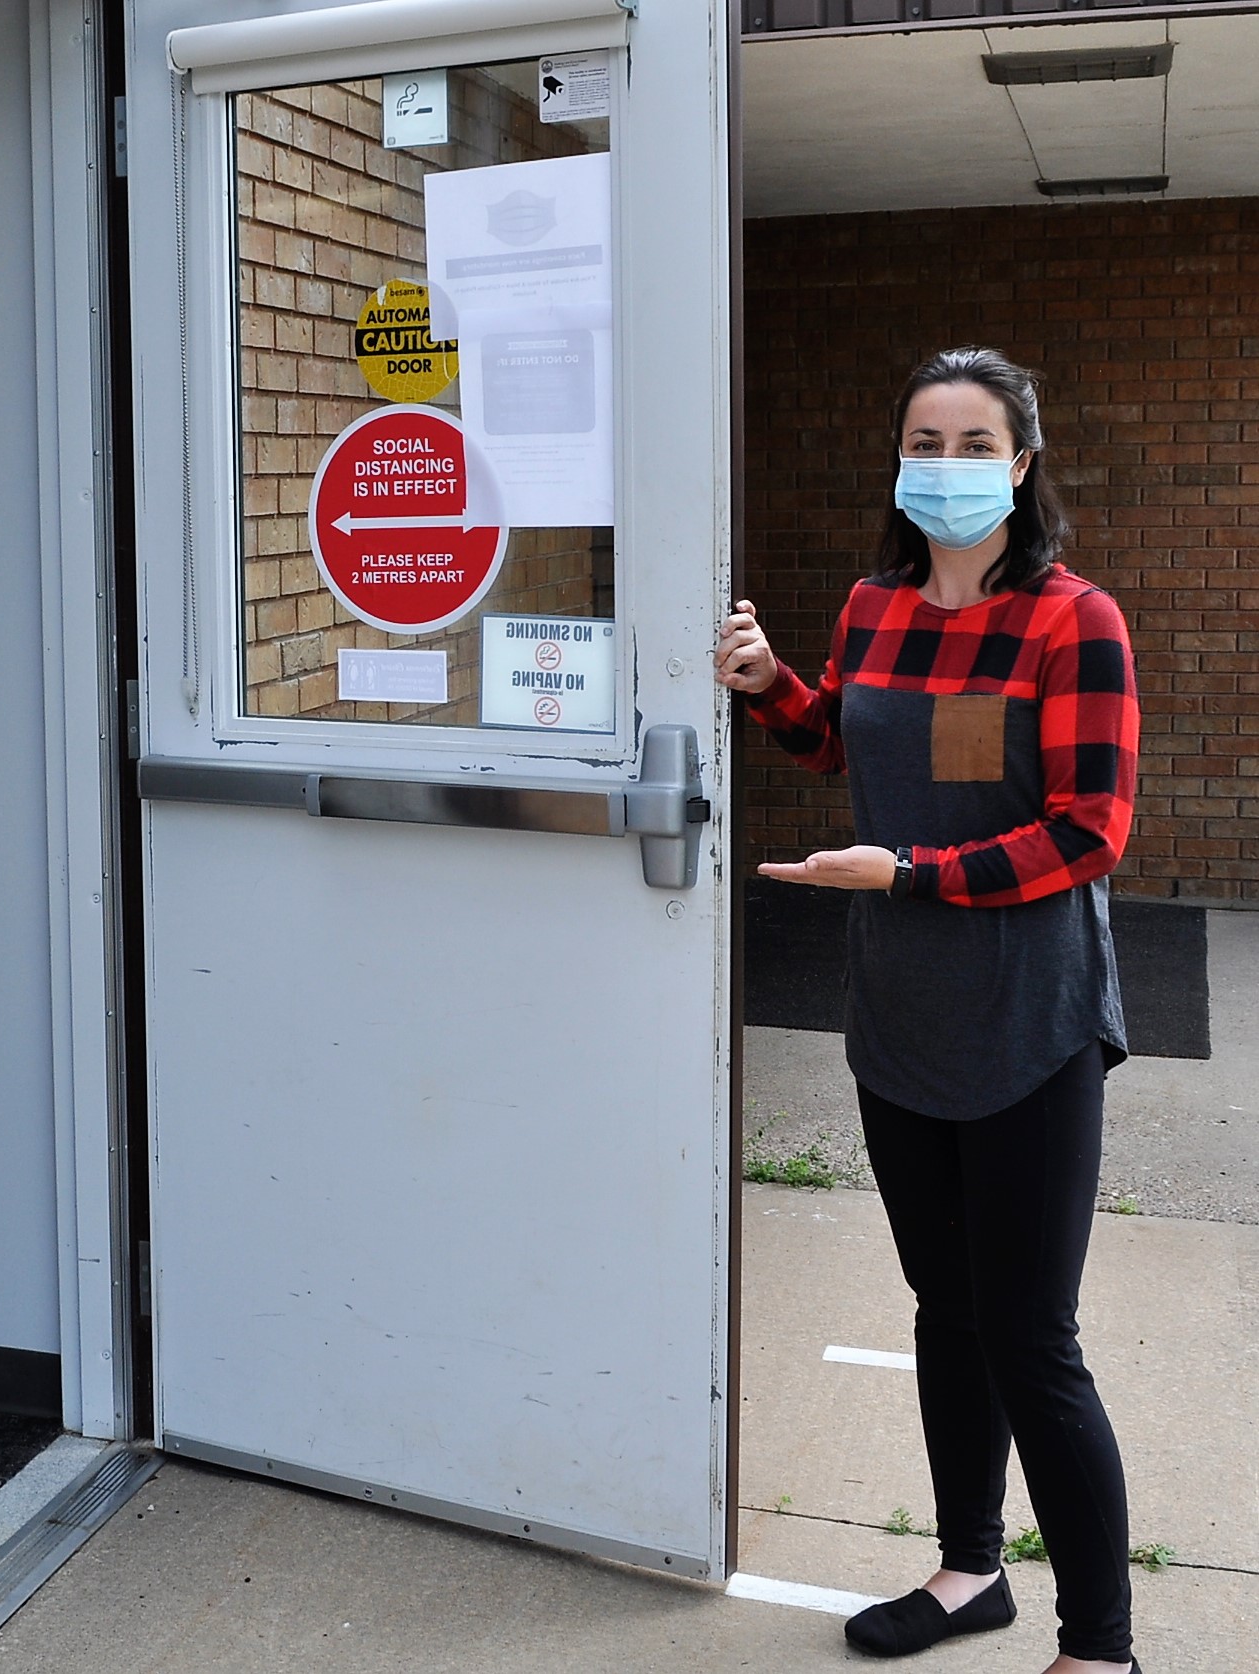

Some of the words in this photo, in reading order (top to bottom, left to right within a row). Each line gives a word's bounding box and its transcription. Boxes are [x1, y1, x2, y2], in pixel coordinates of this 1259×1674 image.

[390, 288, 415, 297] besam
[366, 307, 430, 324] AUTOMA
[387, 359, 432, 375] DOOR
[373, 438, 435, 455] SOCIAL
[355, 458, 454, 476] DISTANCING
[353, 482, 369, 497] IS
[373, 481, 389, 496] IN
[393, 479, 457, 496] EFFECT
[361, 554, 414, 567] PLEASE
[417, 553, 454, 566] KEEP
[352, 572, 360, 584] 2
[362, 571, 417, 584] METRES
[420, 570, 464, 583] APART
